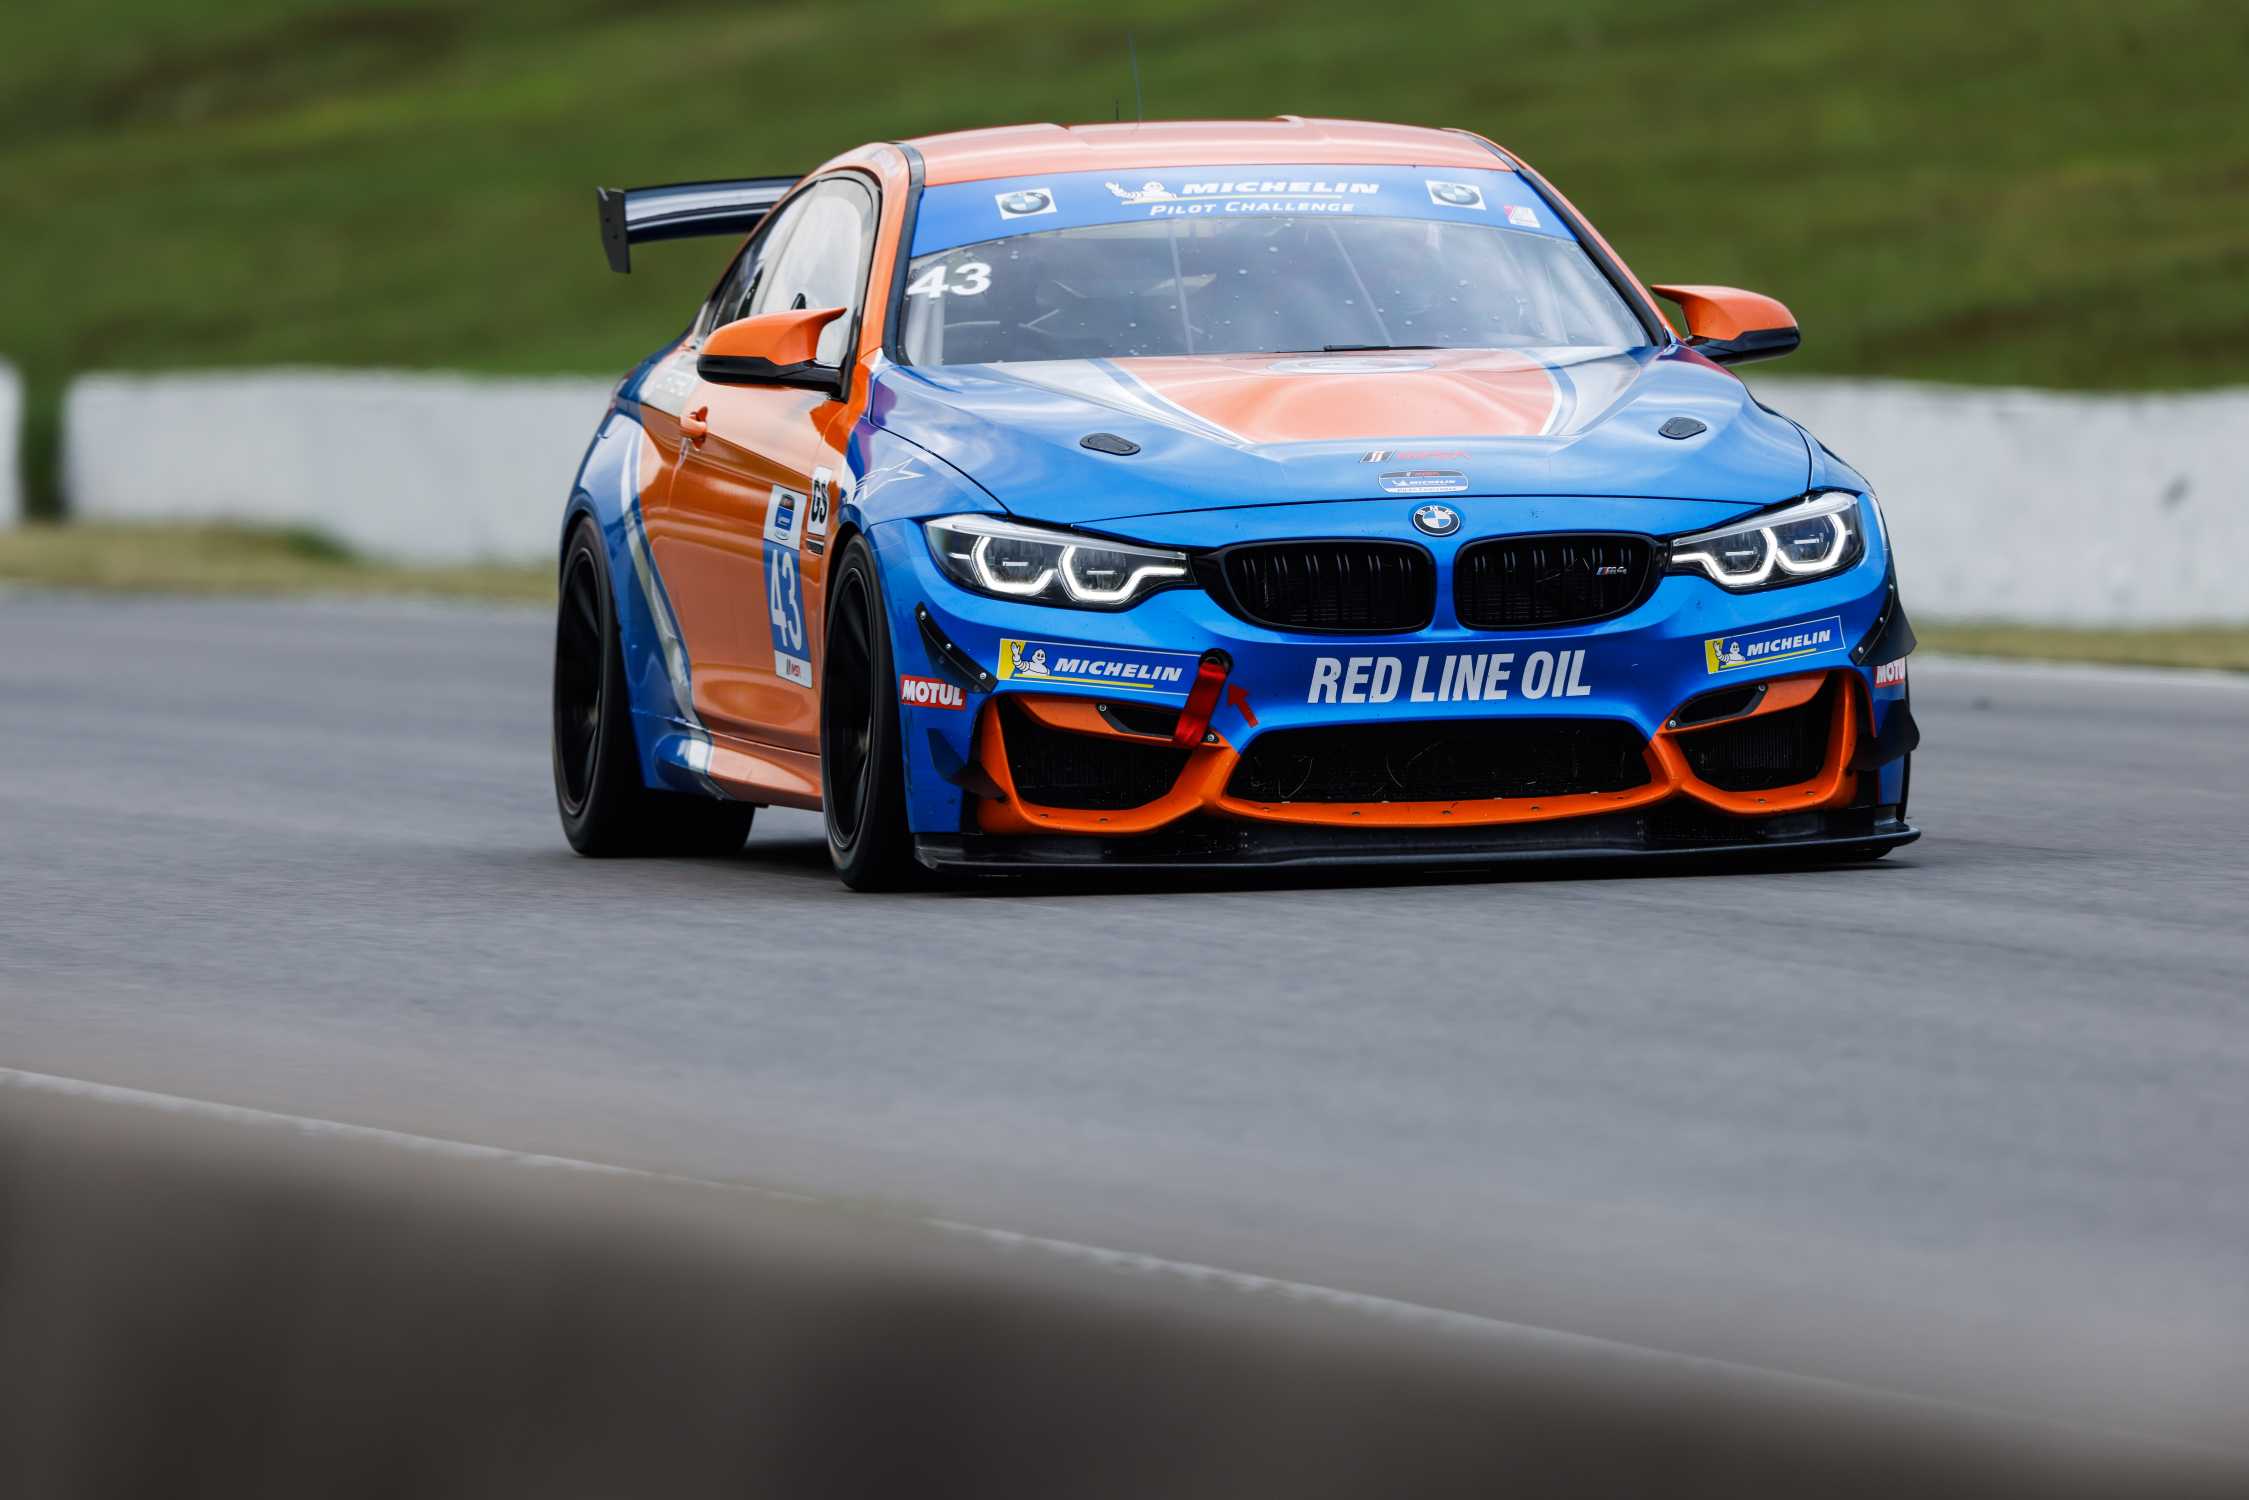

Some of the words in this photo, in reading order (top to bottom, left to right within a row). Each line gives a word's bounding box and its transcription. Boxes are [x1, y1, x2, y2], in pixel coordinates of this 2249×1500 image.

[1182, 182, 1379, 194] MICHELIN
[1150, 203, 1216, 215] PILOT
[1225, 201, 1355, 213] CHALLENGE
[907, 262, 991, 298] 43
[811, 479, 828, 524] GS
[770, 549, 802, 651] 43
[1747, 630, 1831, 657] MICHELIN
[1053, 658, 1183, 682] MICHELIN
[1307, 656, 1403, 704] RED
[1410, 654, 1515, 703] LINE
[1521, 649, 1592, 699] OIL
[1876, 657, 1905, 684] MOTU
[902, 679, 963, 706] MOTUL
